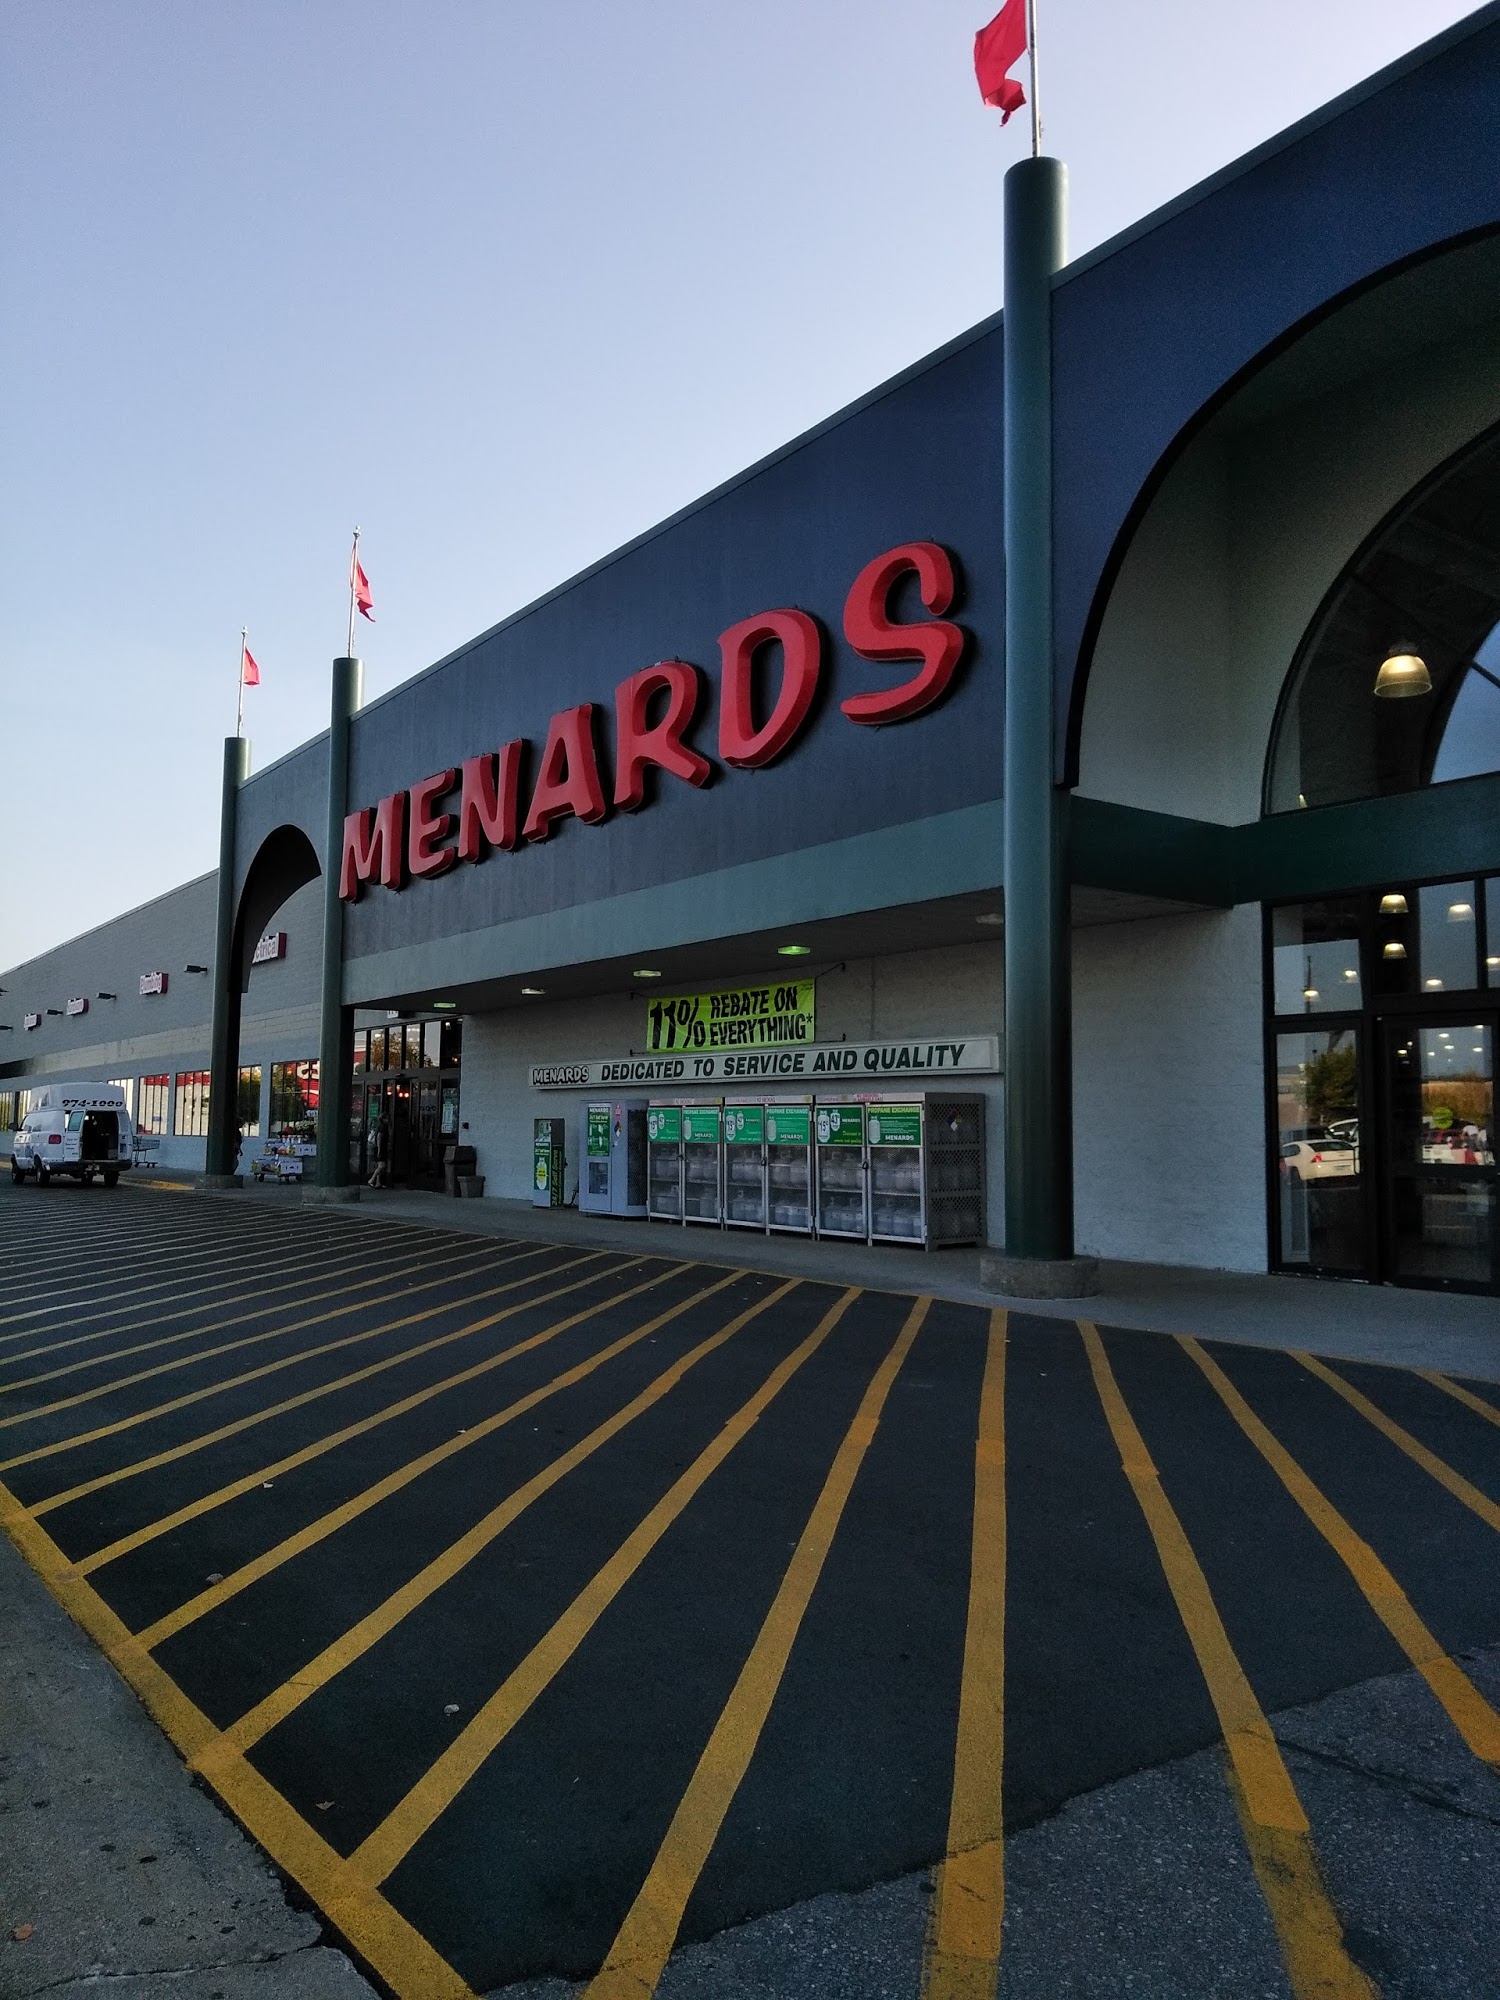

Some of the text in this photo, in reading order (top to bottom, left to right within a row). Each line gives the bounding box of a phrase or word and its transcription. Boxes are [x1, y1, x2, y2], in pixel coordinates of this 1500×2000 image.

[338, 541, 965, 901] MENARDS
[253, 932, 279, 963] ctrical
[710, 986, 797, 1019] REBATE ON
[650, 997, 706, 1049] 11%
[533, 1044, 966, 1085] MENARDS DEDICATED TO SERVICE AND QUALITY
[62, 1099, 123, 1107] 974-1000
